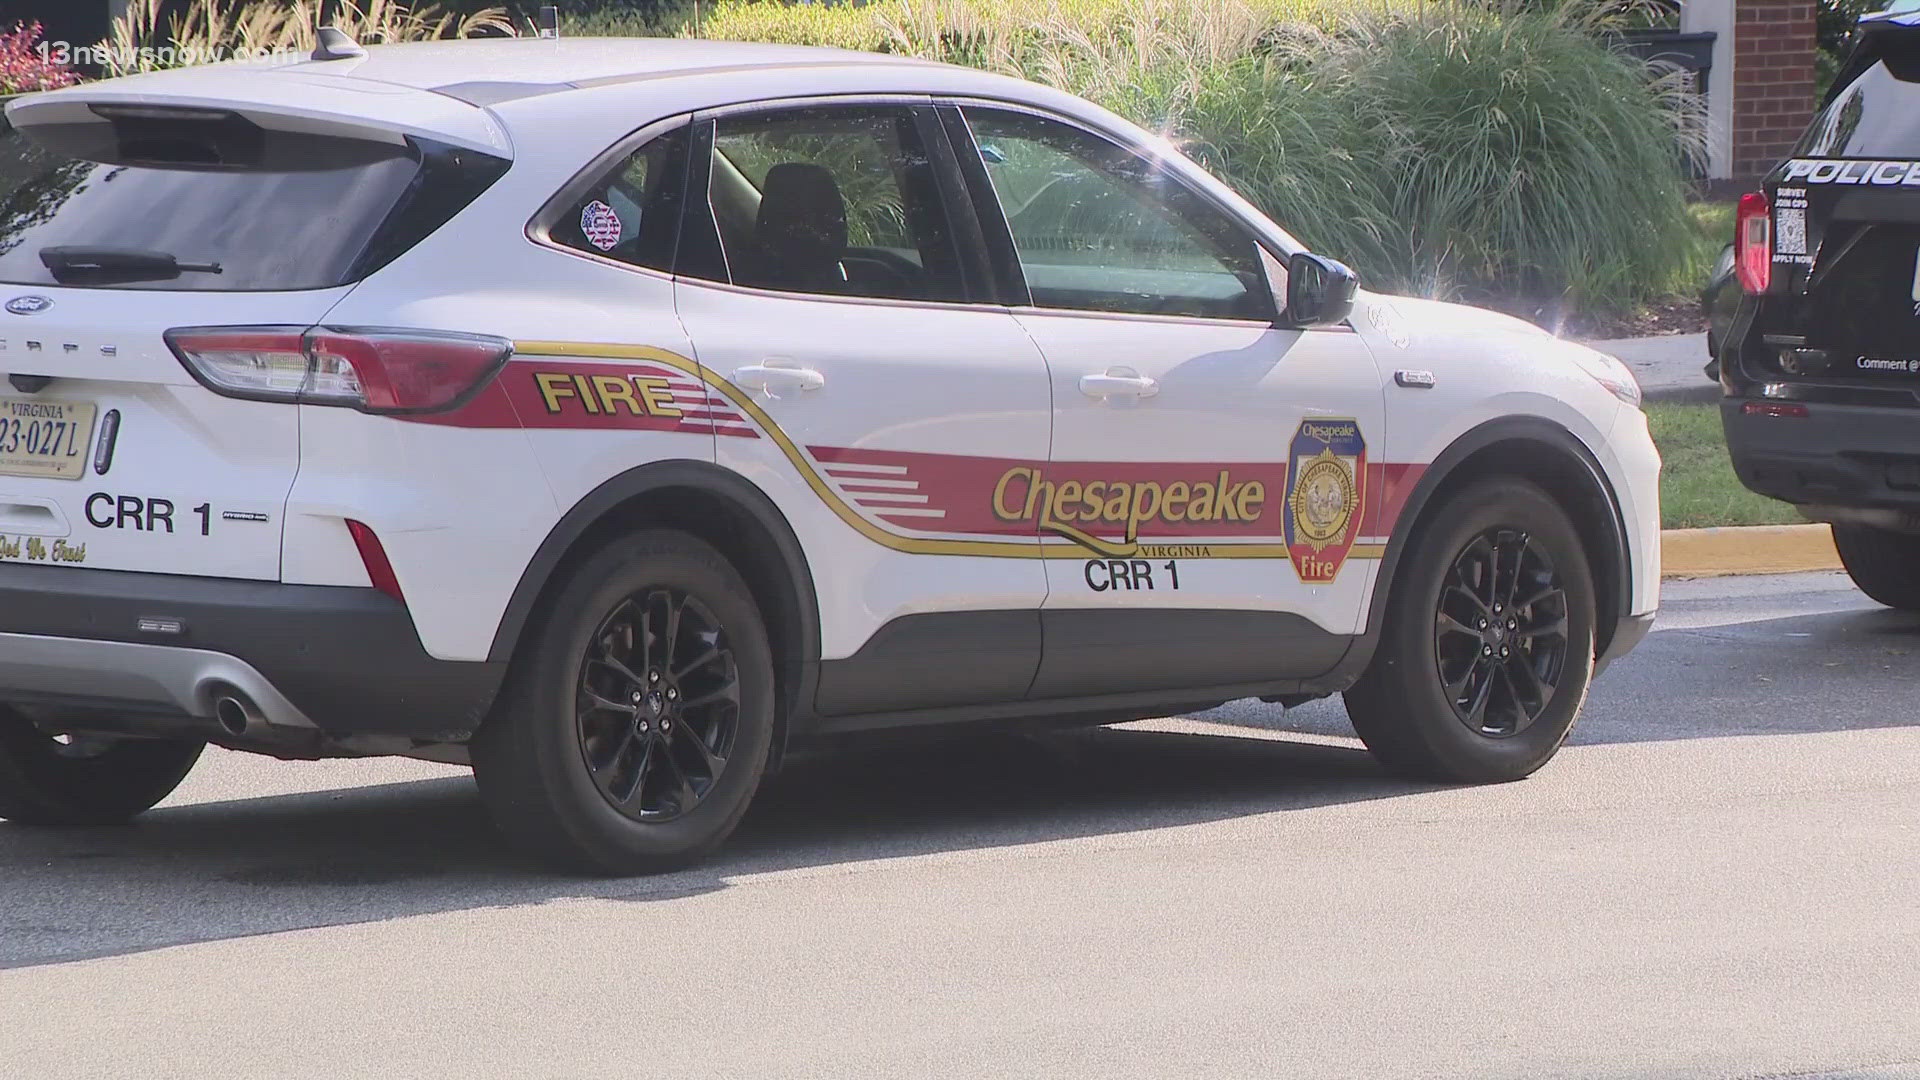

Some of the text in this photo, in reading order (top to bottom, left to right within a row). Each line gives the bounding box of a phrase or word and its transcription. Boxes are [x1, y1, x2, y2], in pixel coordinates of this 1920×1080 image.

[1782, 159, 1920, 186] POLICE
[1776, 187, 1807, 198] SURVEY
[1775, 199, 1808, 209] JOIN CPD
[1772, 255, 1813, 264] APPLY NOW
[1857, 355, 1907, 371] Comment
[534, 371, 685, 419] FIRE
[11, 402, 63, 419] VIRGINIA
[1302, 423, 1356, 443] Chesapeake
[85, 492, 211, 536] CRR 1
[992, 466, 1265, 556] Chesapeake
[1141, 546, 1211, 557] VIRGINIA
[1084, 560, 1179, 591] CRR 1
[1301, 555, 1334, 577] Fire
